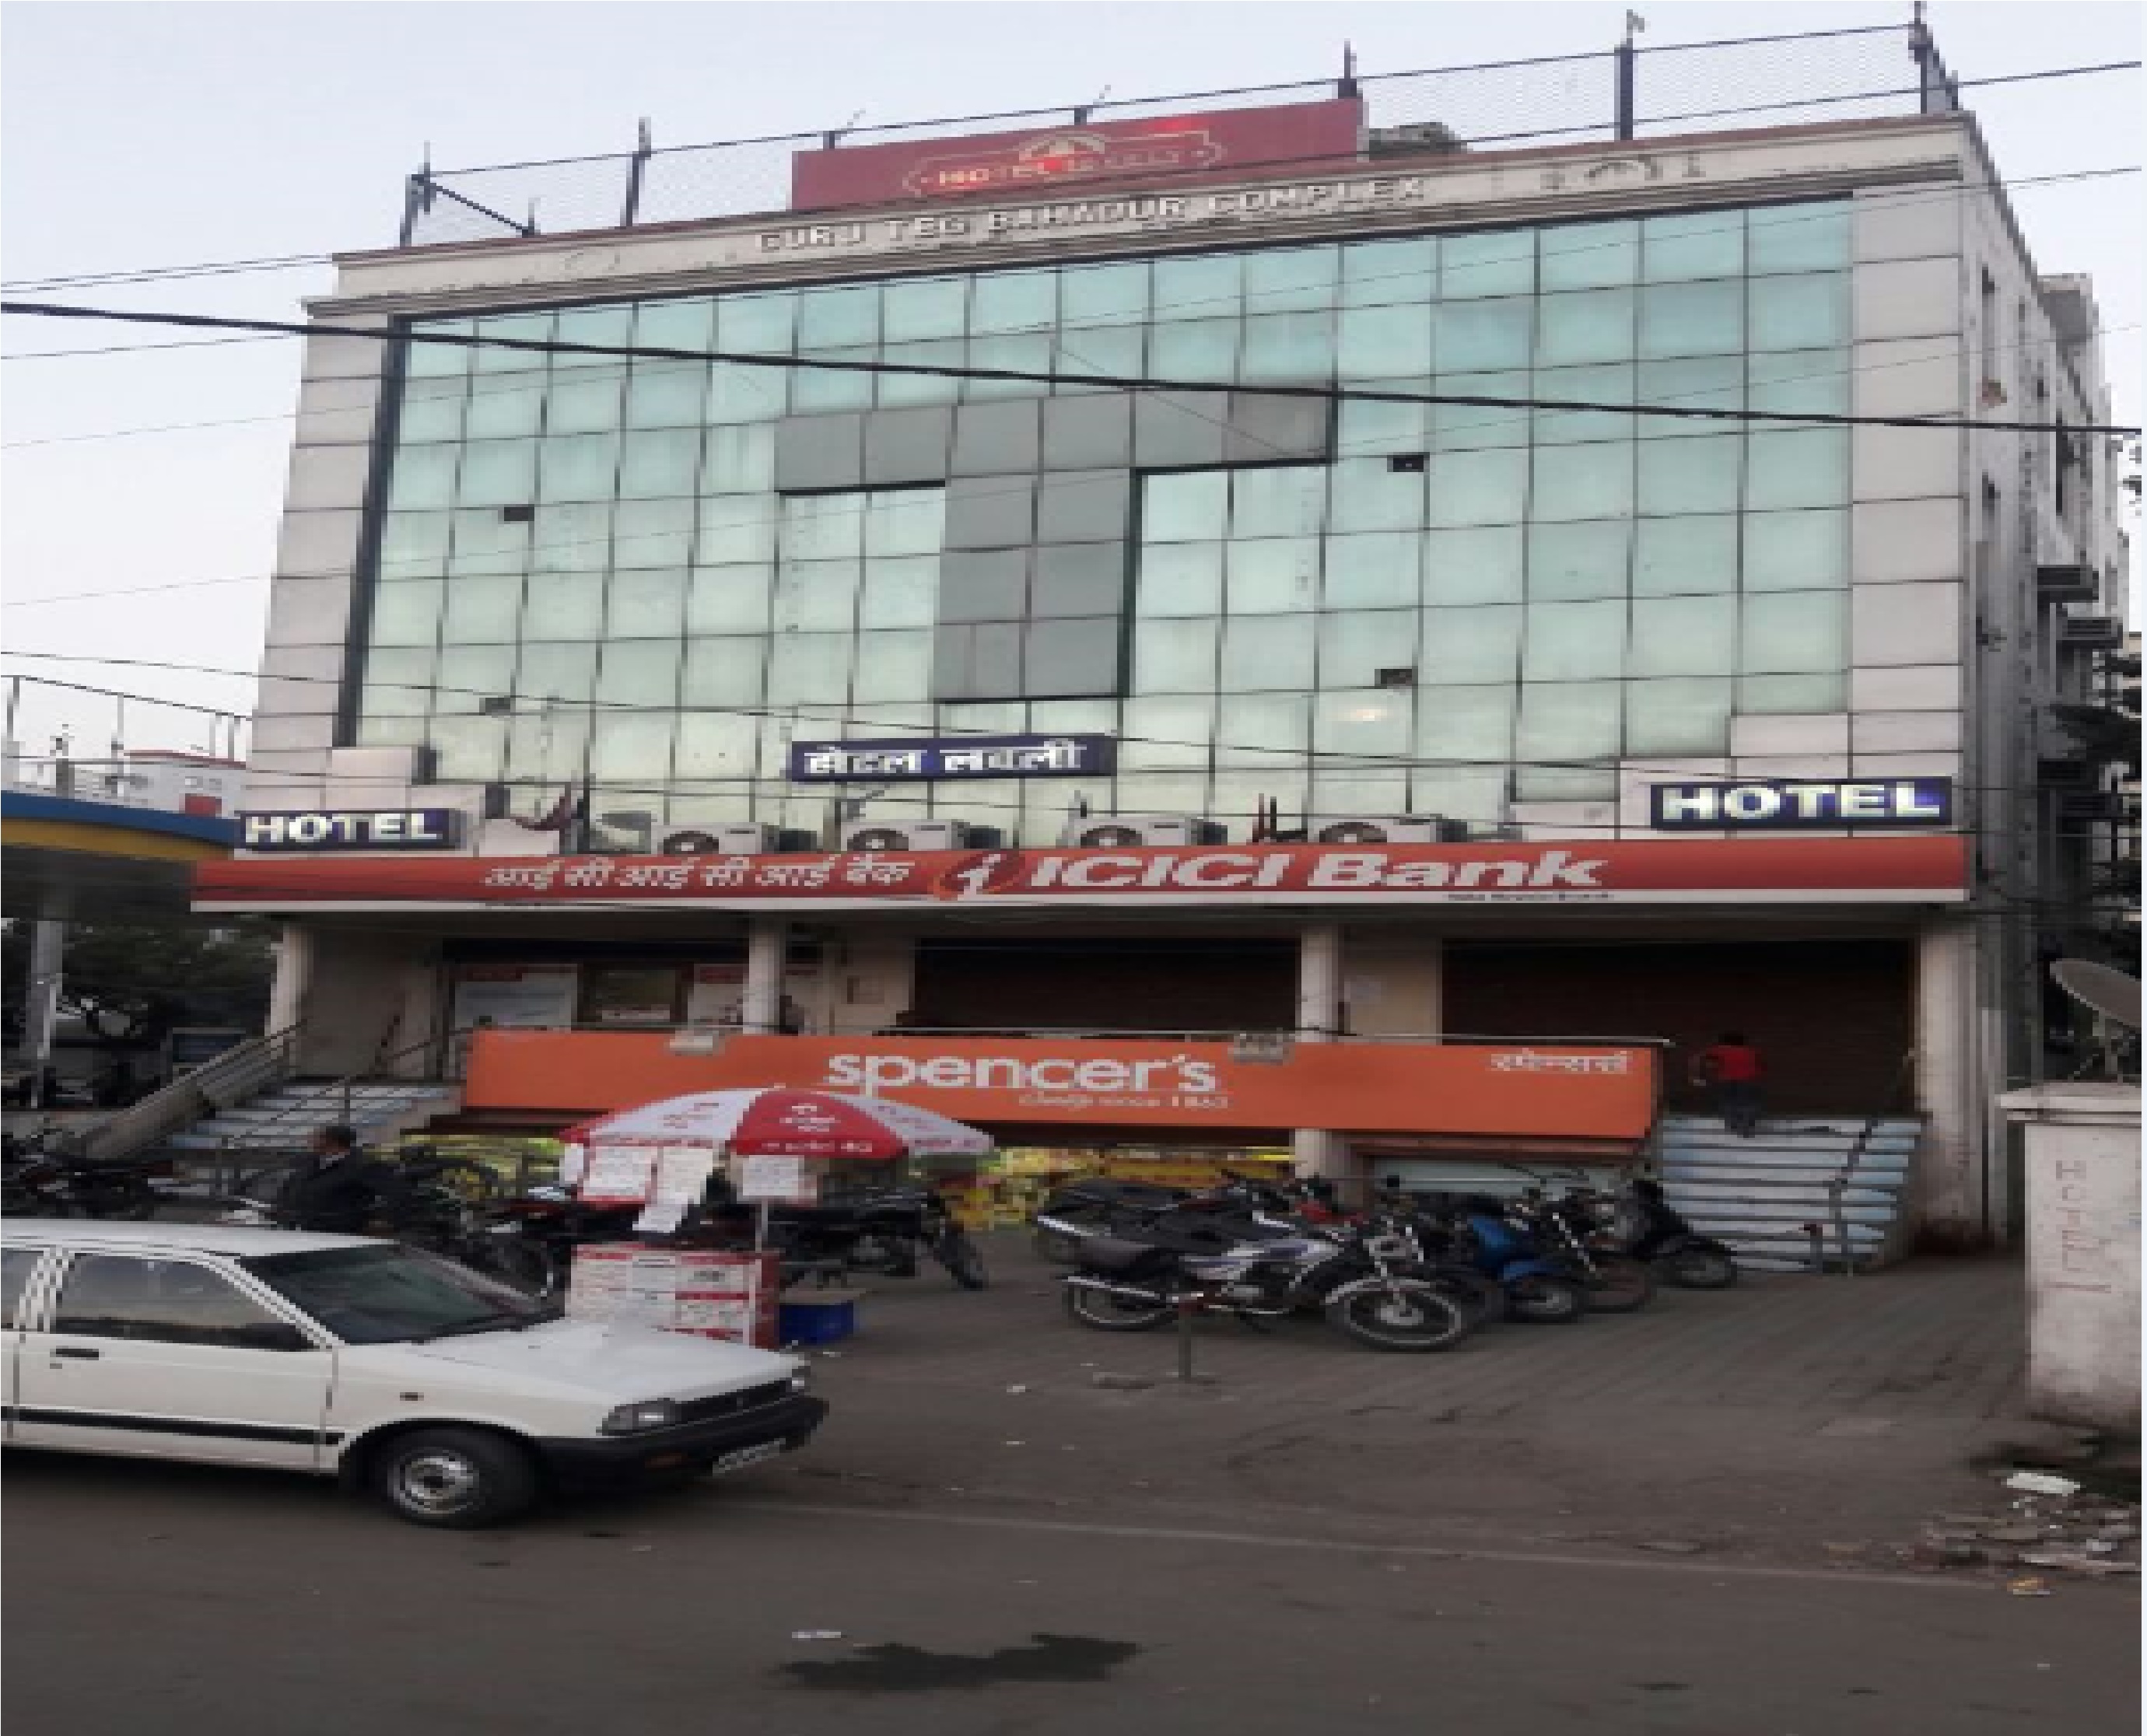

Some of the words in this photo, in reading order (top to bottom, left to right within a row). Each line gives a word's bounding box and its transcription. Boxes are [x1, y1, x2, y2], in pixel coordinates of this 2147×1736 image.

[1207, 177, 1424, 215] COMPLEX
[1661, 780, 1941, 821] HOTEL
[244, 813, 444, 843] HOTEL
[1030, 853, 1297, 887] ICICI
[1307, 850, 1609, 887] Bank
[828, 1052, 1217, 1098] spencer's
